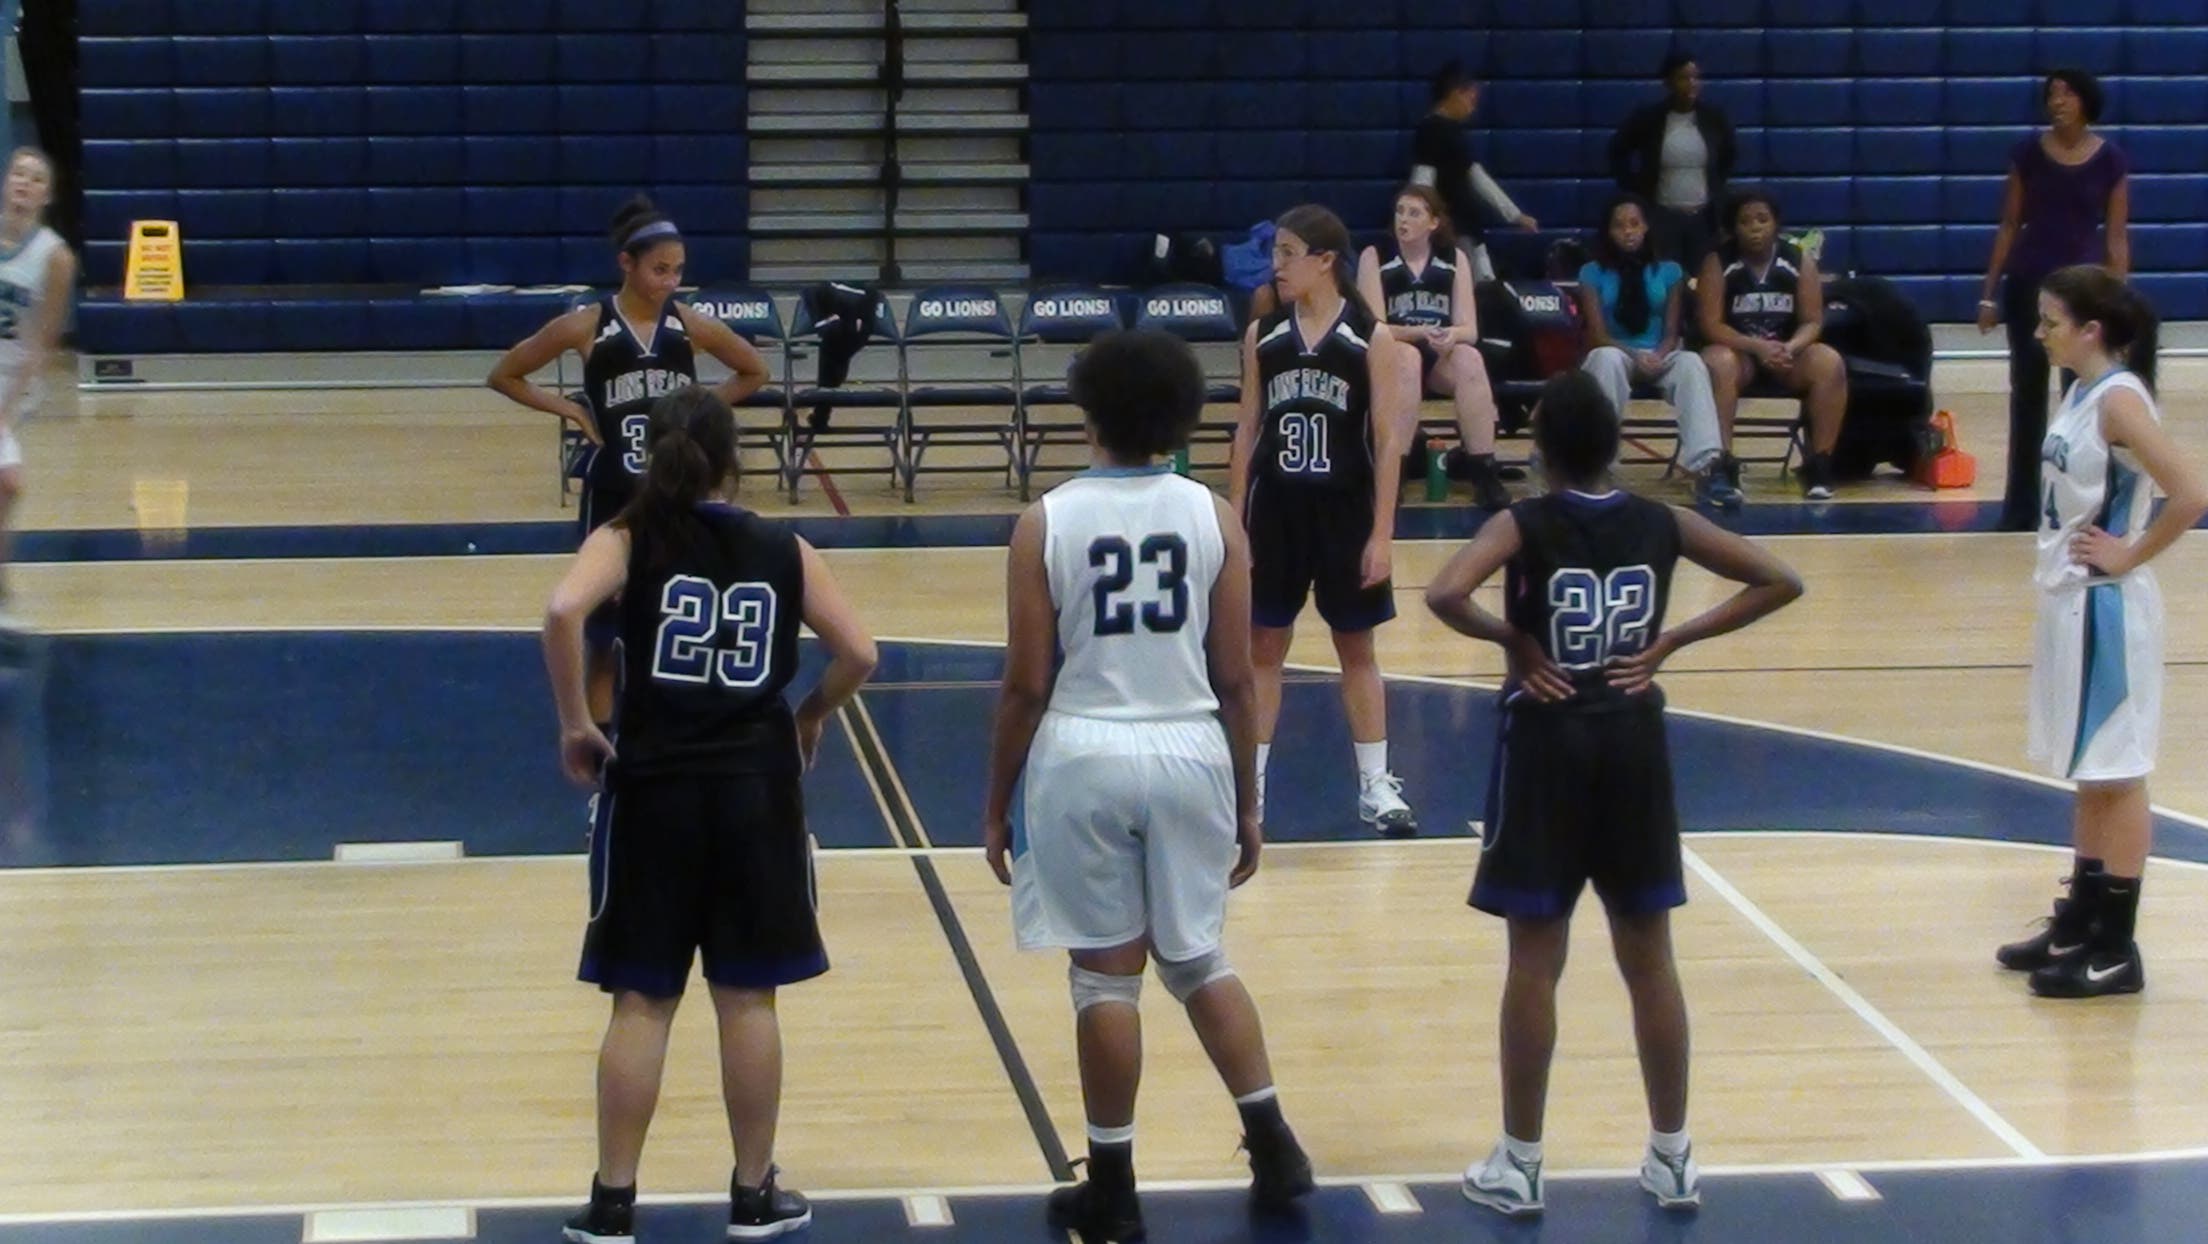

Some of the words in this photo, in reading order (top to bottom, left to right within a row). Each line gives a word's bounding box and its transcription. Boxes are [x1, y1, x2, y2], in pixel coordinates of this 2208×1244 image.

[693, 301, 715, 318] GO
[719, 302, 768, 319] LIONS!
[920, 300, 942, 317] GO
[949, 300, 996, 317] LIONS!
[1033, 300, 1056, 317] GO
[1060, 299, 1110, 317] LIONS!
[1147, 300, 1170, 316] GO
[1173, 299, 1223, 316] LIONS!
[605, 370, 644, 408] LONG
[645, 368, 692, 398] BEAC
[1267, 369, 1300, 410] LONG
[1300, 368, 1350, 411] BEACH
[621, 413, 651, 474] 3
[1279, 412, 1331, 473] 31
[1087, 531, 1189, 637] 23
[651, 573, 777, 688] 23
[1548, 563, 1657, 671] 22
